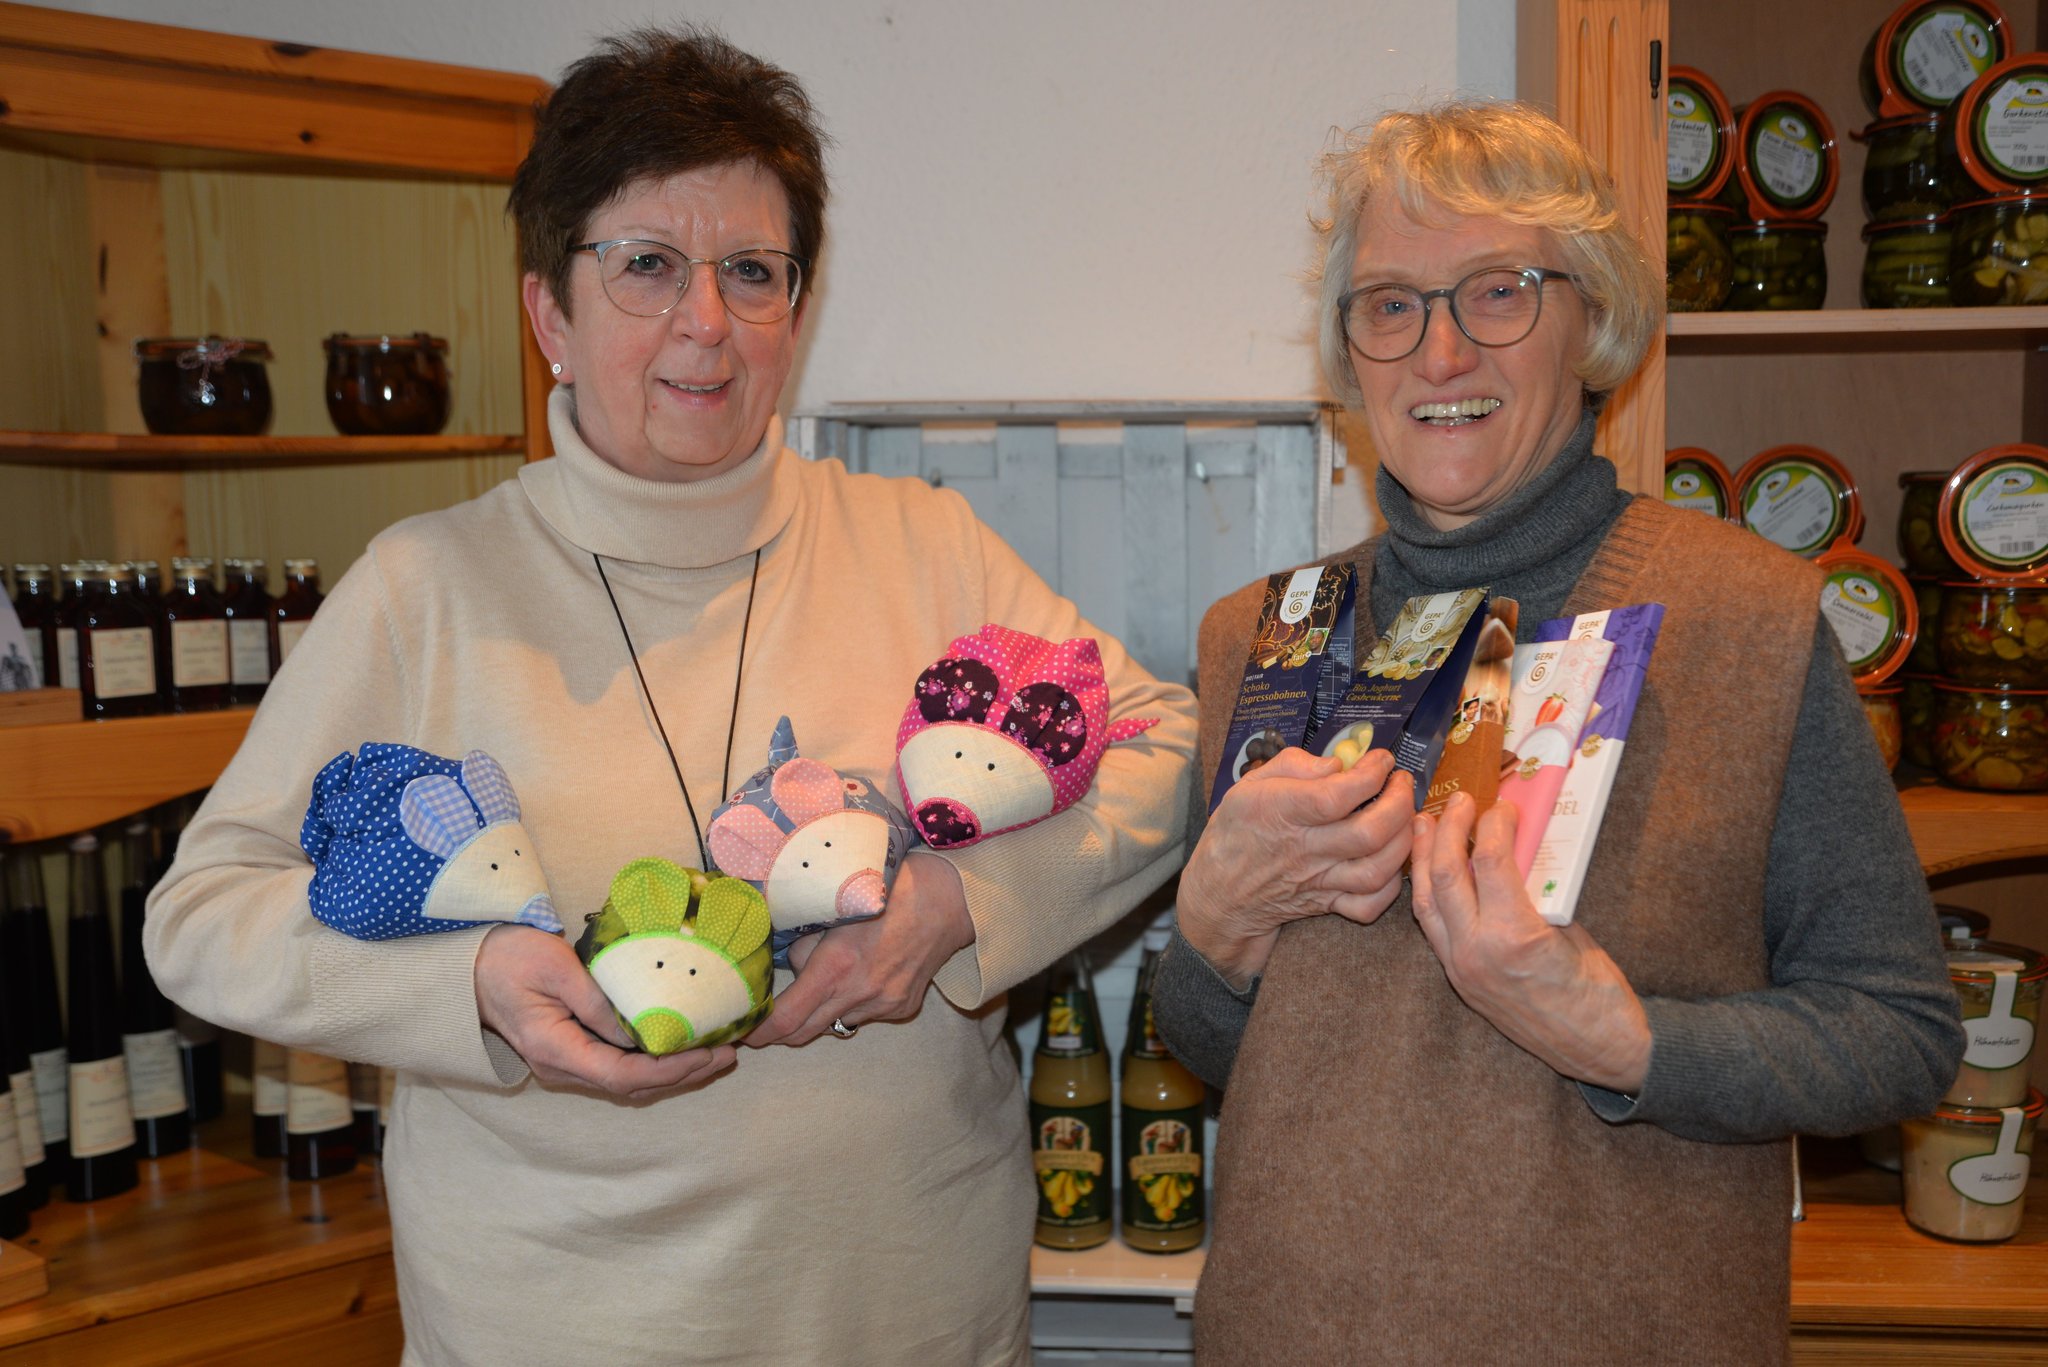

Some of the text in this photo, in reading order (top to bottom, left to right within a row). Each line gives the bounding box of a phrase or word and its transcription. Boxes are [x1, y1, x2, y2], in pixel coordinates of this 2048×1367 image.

[1243, 682, 1270, 694] Schoko
[1352, 683, 1402, 694] Bio Joghurt
[1240, 689, 1307, 705] Espressobohnen
[1346, 693, 1402, 702] Cashewkerne
